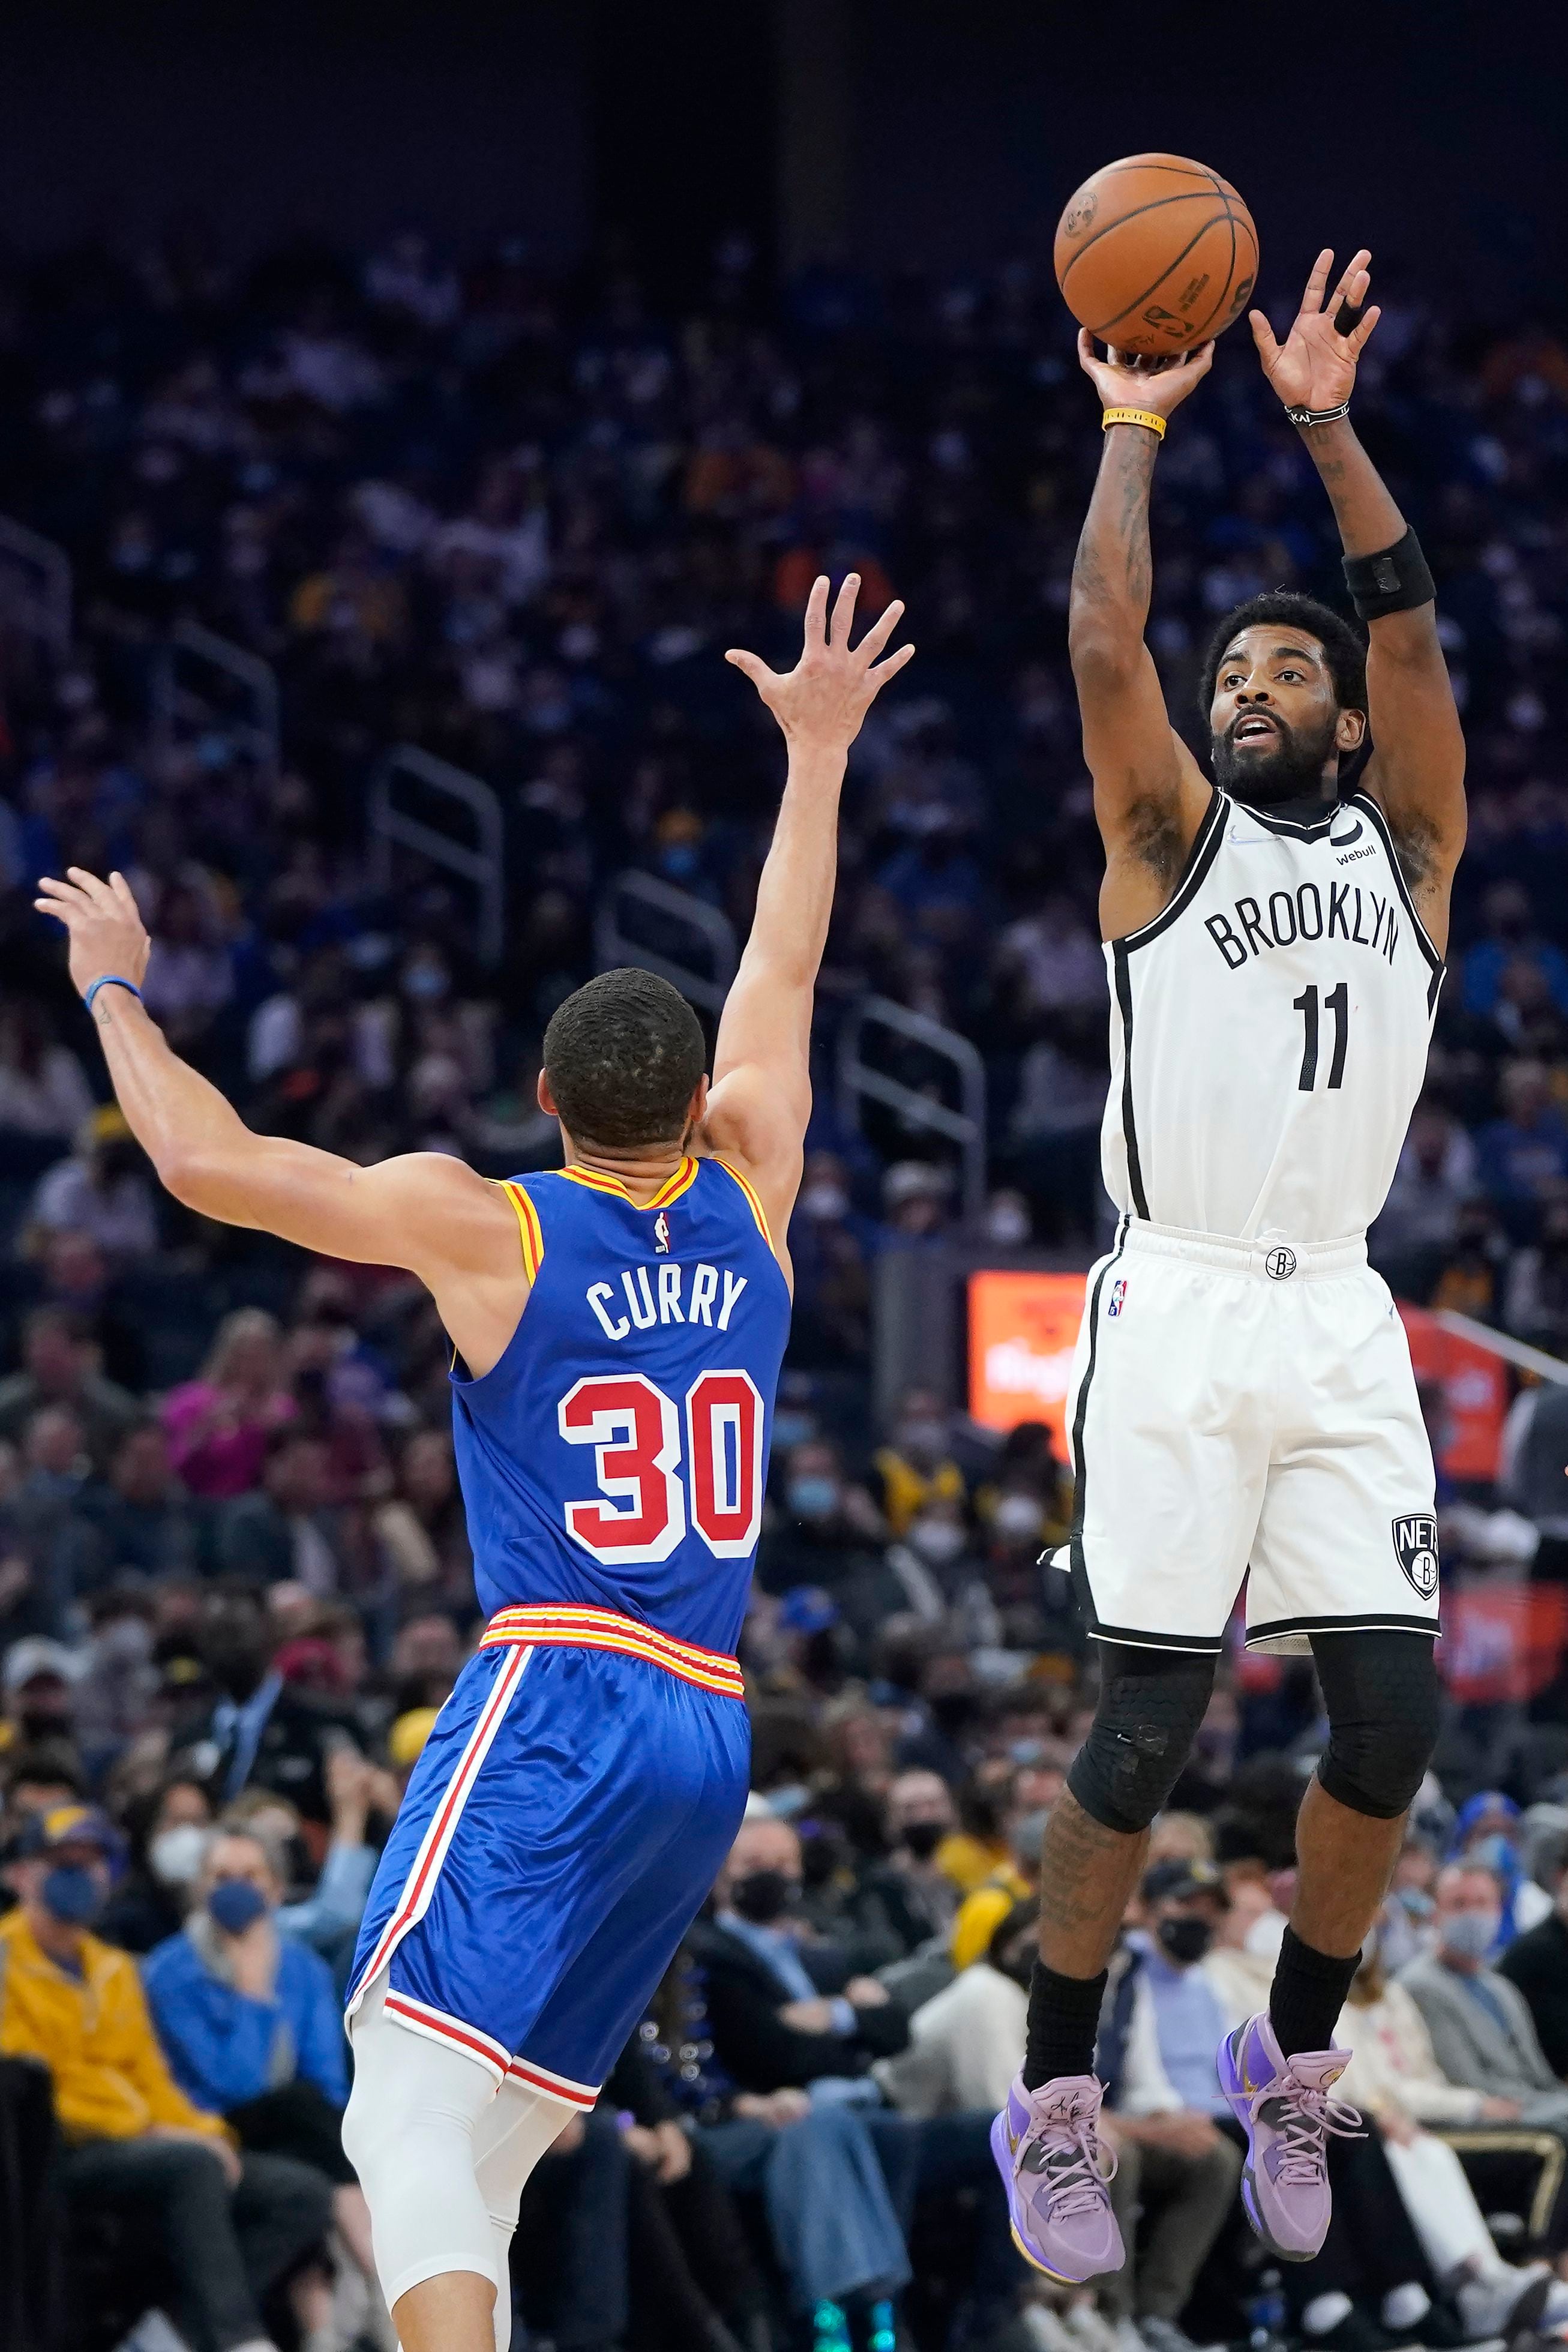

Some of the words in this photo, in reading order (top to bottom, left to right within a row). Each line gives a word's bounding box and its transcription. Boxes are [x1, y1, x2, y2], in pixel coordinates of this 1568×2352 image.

[1204, 882, 1398, 969] BROOKLYN
[1293, 982, 1348, 1091] 11
[586, 1263, 748, 1341] CURRY
[1276, 1253, 1286, 1275] B
[557, 1369, 764, 1565] 30
[1423, 1557, 1430, 1584] B
